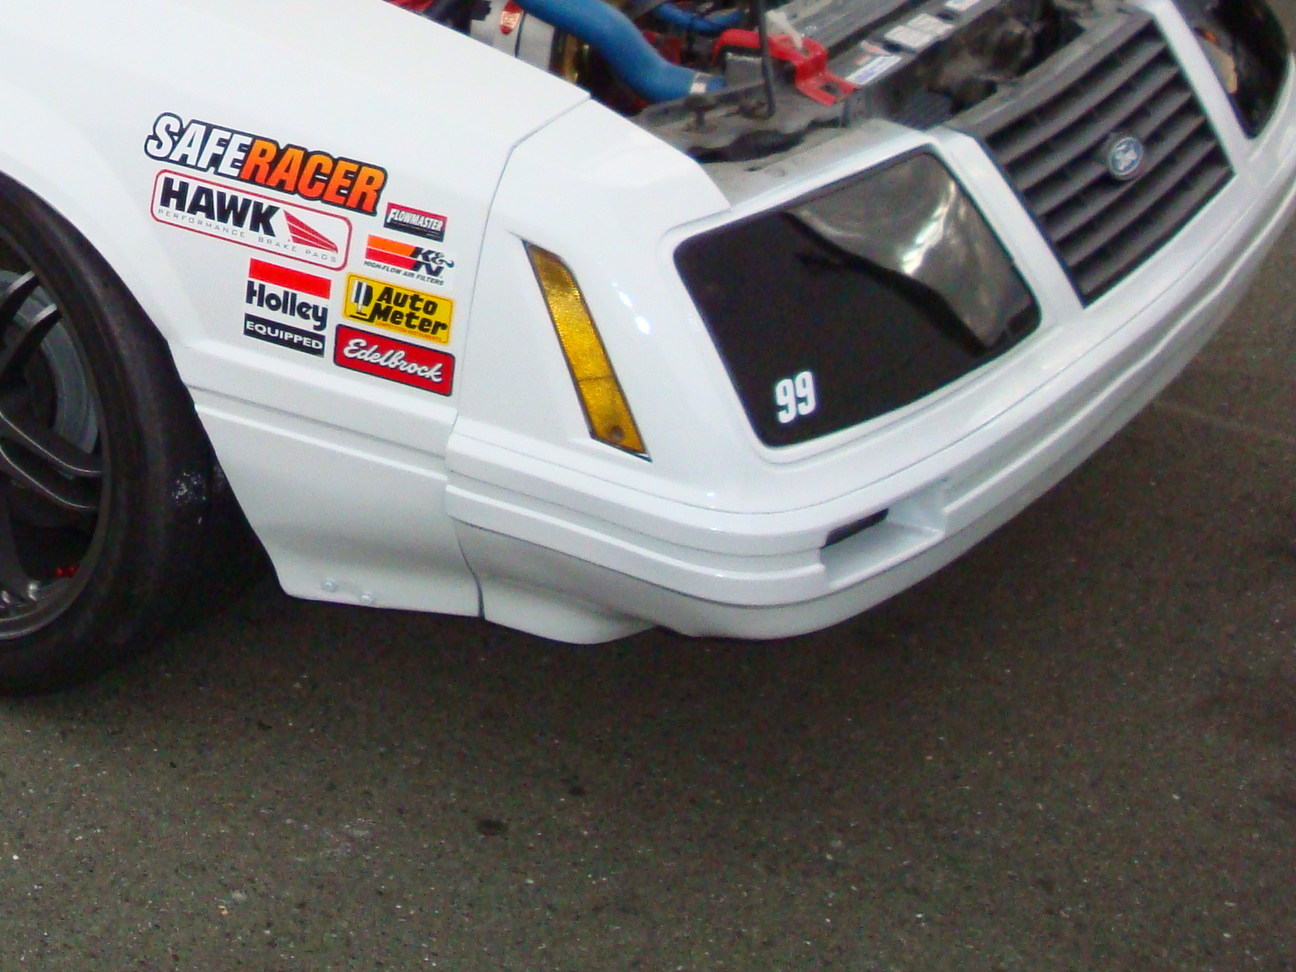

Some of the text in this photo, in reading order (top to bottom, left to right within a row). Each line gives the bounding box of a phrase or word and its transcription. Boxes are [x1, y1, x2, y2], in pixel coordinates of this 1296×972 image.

[144, 113, 387, 216] SAFERACER
[160, 176, 281, 238] HAWK
[386, 208, 444, 232] FLOWMASTER
[157, 208, 337, 264] PERFORMANCE BRAKE PADS
[363, 260, 445, 287] HIGH-FLOW AIR FILTERS
[246, 280, 328, 332] Holley
[368, 302, 448, 335] Meter
[376, 286, 438, 316] Auto
[245, 320, 323, 350] EQUIPPED
[344, 338, 443, 383] Edelbrock
[775, 370, 816, 424] 99
